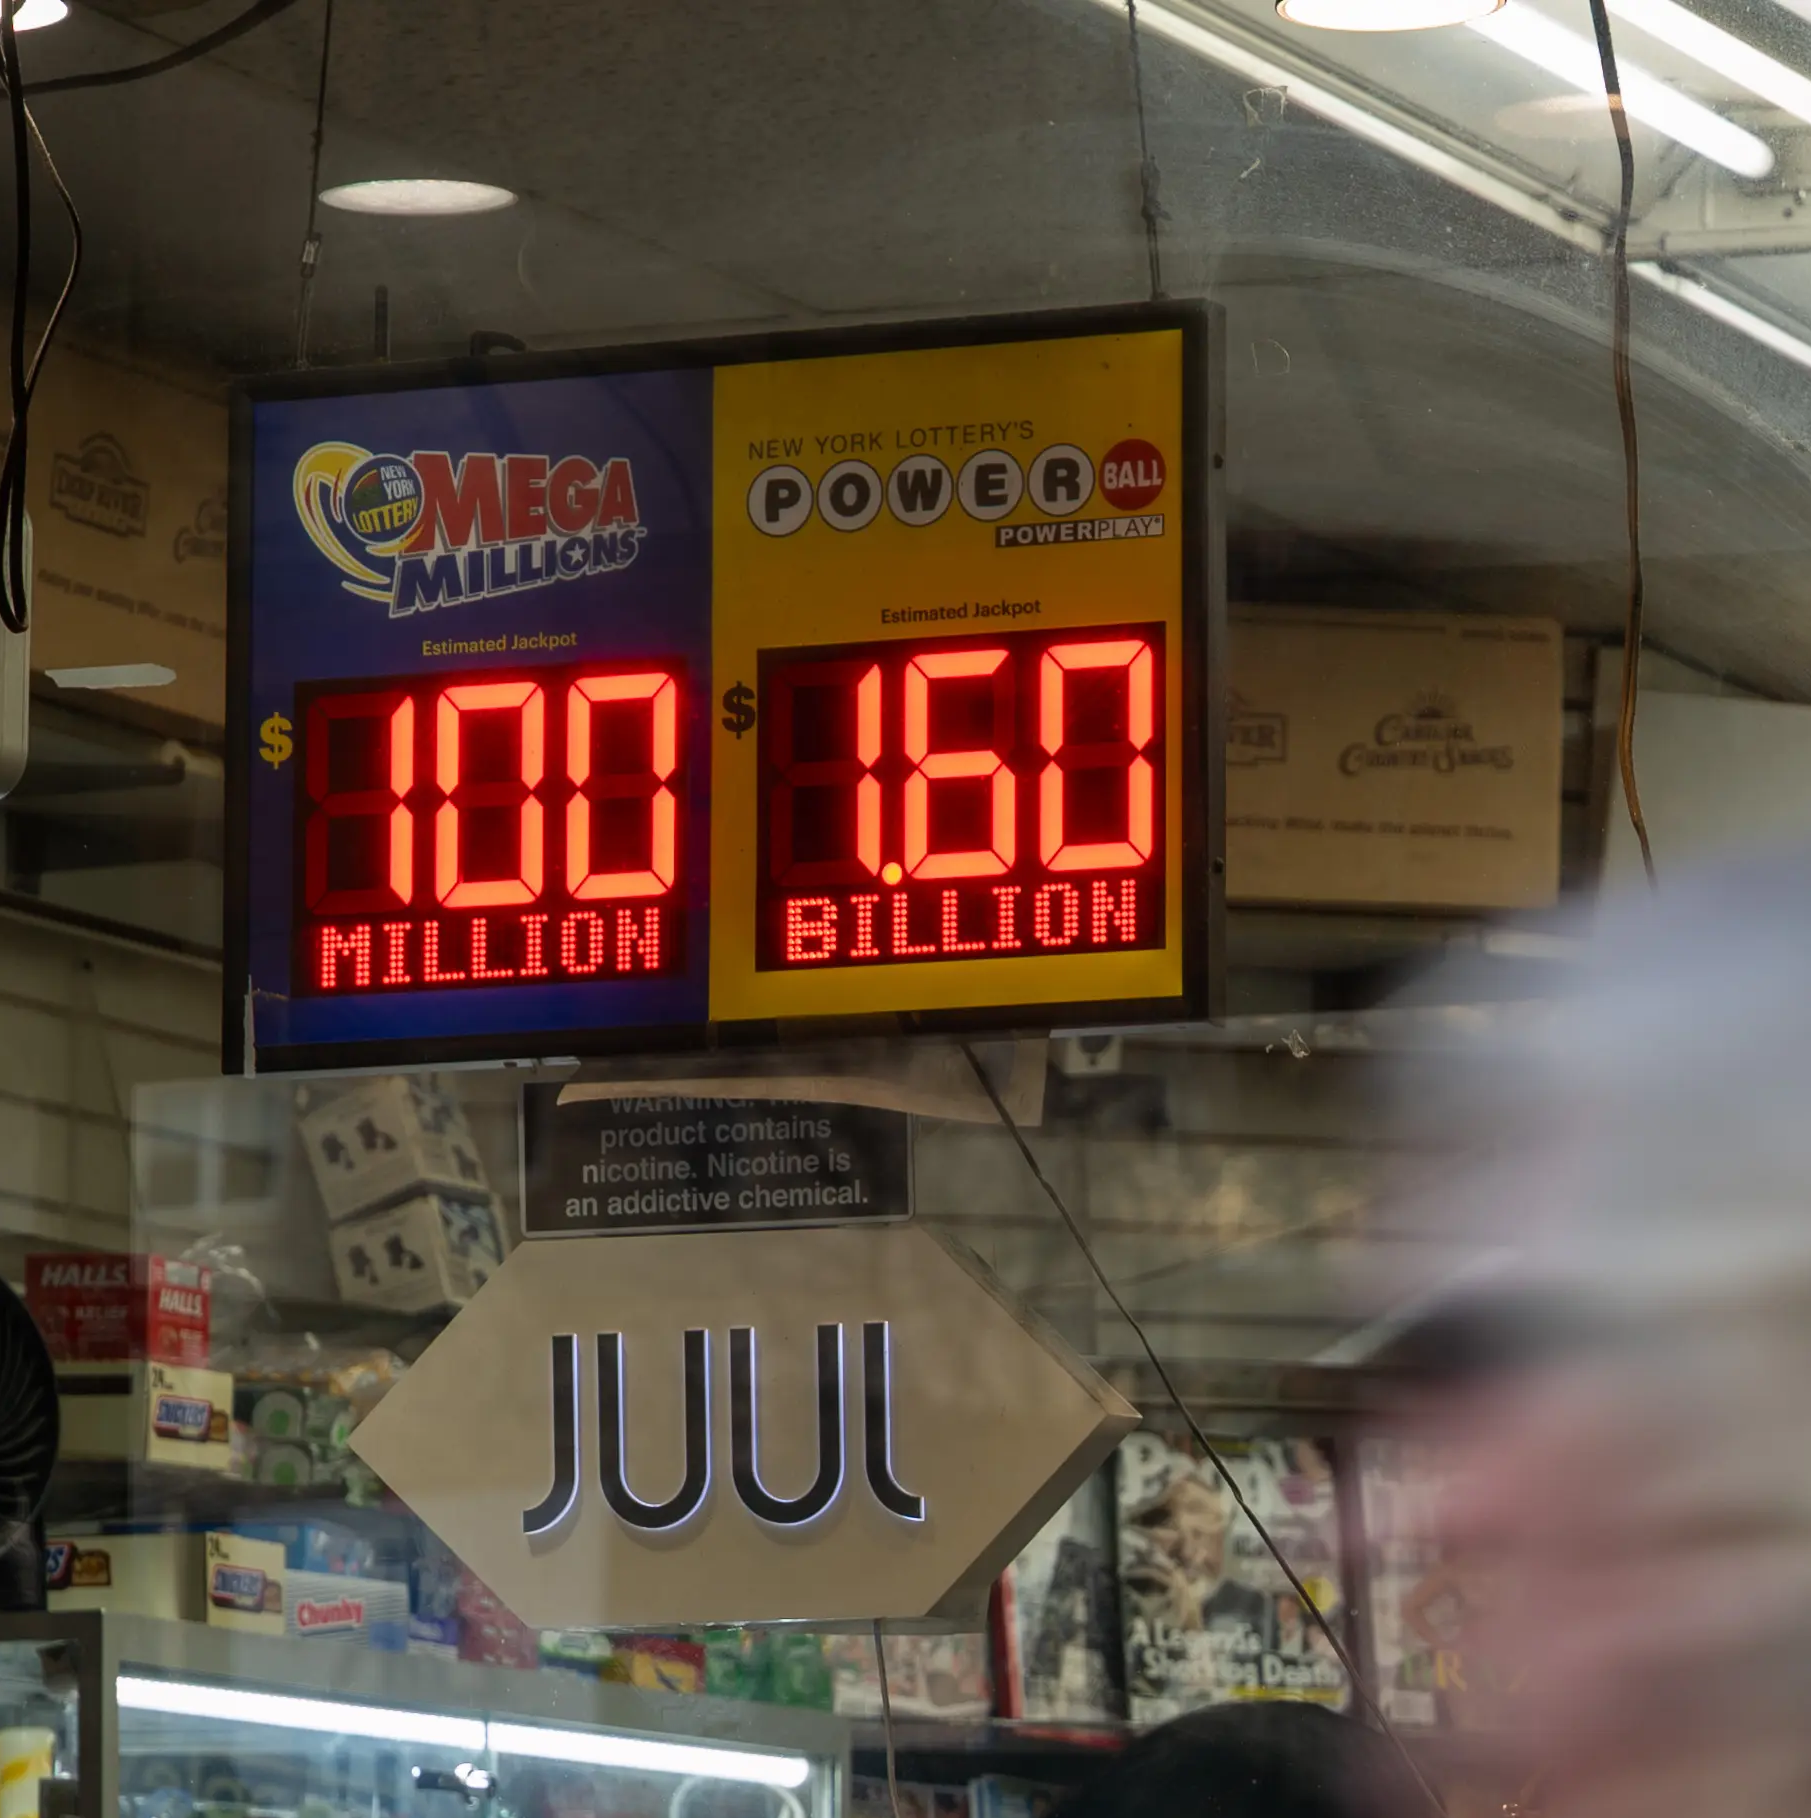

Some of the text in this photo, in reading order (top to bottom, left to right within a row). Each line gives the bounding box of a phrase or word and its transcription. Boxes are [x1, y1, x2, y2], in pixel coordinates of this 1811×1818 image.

[748, 420, 1035, 460] NEW YORK LOTTERY'S
[402, 452, 639, 556] MEGA
[388, 530, 640, 618] MILLIONS
[881, 599, 1042, 625] Estimated Jackpot
[421, 632, 578, 657] Estimated Jackpot
[722, 638, 1153, 880] $ 1.60
[259, 671, 676, 910] $ 100
[321, 907, 661, 988] MILLION
[787, 878, 1139, 962] BILLION
[600, 1115, 833, 1155] product contains
[582, 1147, 852, 1185] nicotine. Nicotine is
[565, 1179, 870, 1219] an addictive chemical.
[159, 1287, 203, 1318] HALLS
[521, 1320, 926, 1535] JUUL
